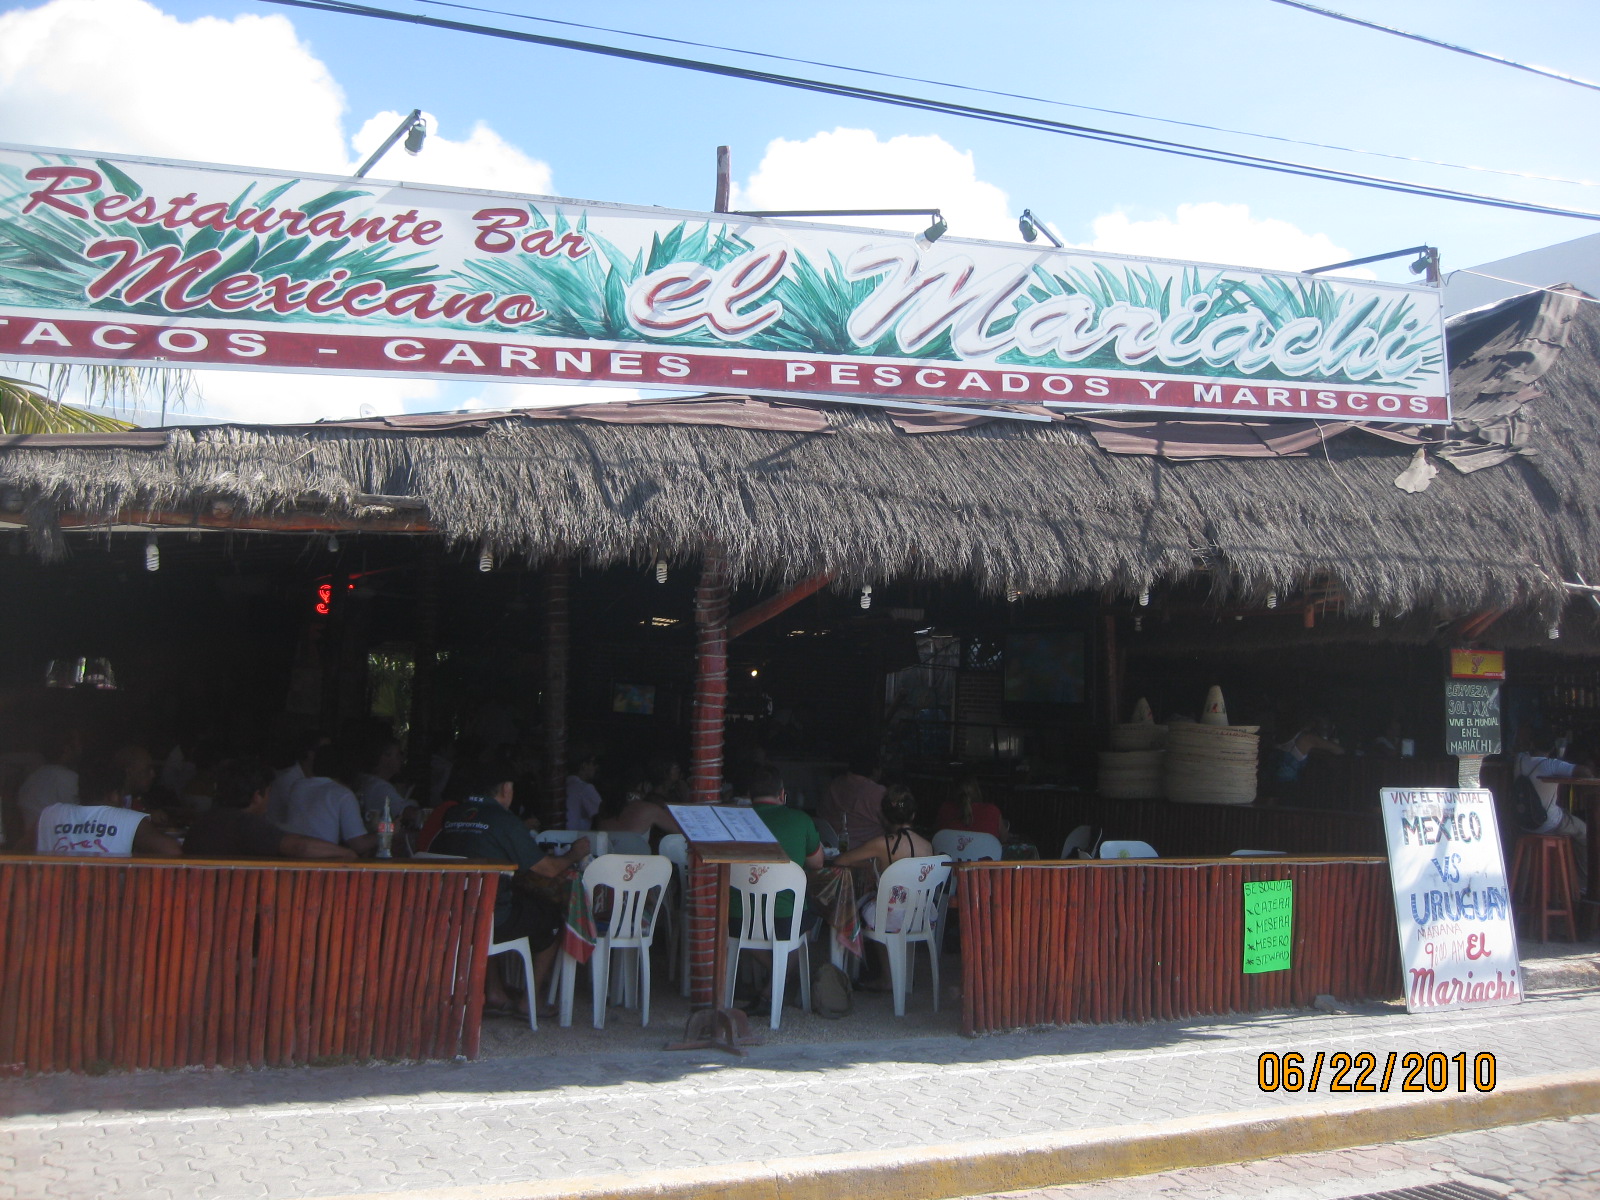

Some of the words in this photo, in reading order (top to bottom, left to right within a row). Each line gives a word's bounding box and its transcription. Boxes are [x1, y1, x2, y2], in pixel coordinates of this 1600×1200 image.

[22, 166, 443, 246] Restaurante
[472, 207, 591, 260] Bar
[86, 239, 549, 326] Mexicano
[626, 241, 784, 342] el
[846, 243, 1422, 379] Mariachi
[0, 319, 267, 358] ACOS
[384, 339, 692, 378] CARNES
[787, 362, 1111, 397] PESCADOS
[1140, 380, 1167, 399] Y
[1194, 383, 1430, 414] MARISCOS
[1446, 684, 1490, 698] CERVEZA
[1448, 700, 1467, 715] SOL
[1449, 718, 1464, 727] VIVE
[1466, 717, 1473, 727] EL
[1474, 716, 1499, 727] MUNDIAL
[1450, 739, 1492, 753] MARIACHI
[1391, 791, 1418, 805] VIVE
[1420, 791, 1433, 803] EL
[1436, 791, 1484, 804] MUNDIAL
[54, 820, 118, 838] contigo
[1401, 811, 1482, 846] MEXICO
[1431, 853, 1462, 883] VS
[1245, 882, 1257, 896] SE
[1254, 897, 1290, 915] CAJERA
[1256, 915, 1290, 934] MESERA
[1255, 935, 1289, 951] MESERO
[1409, 967, 1520, 1007] Mariachi
